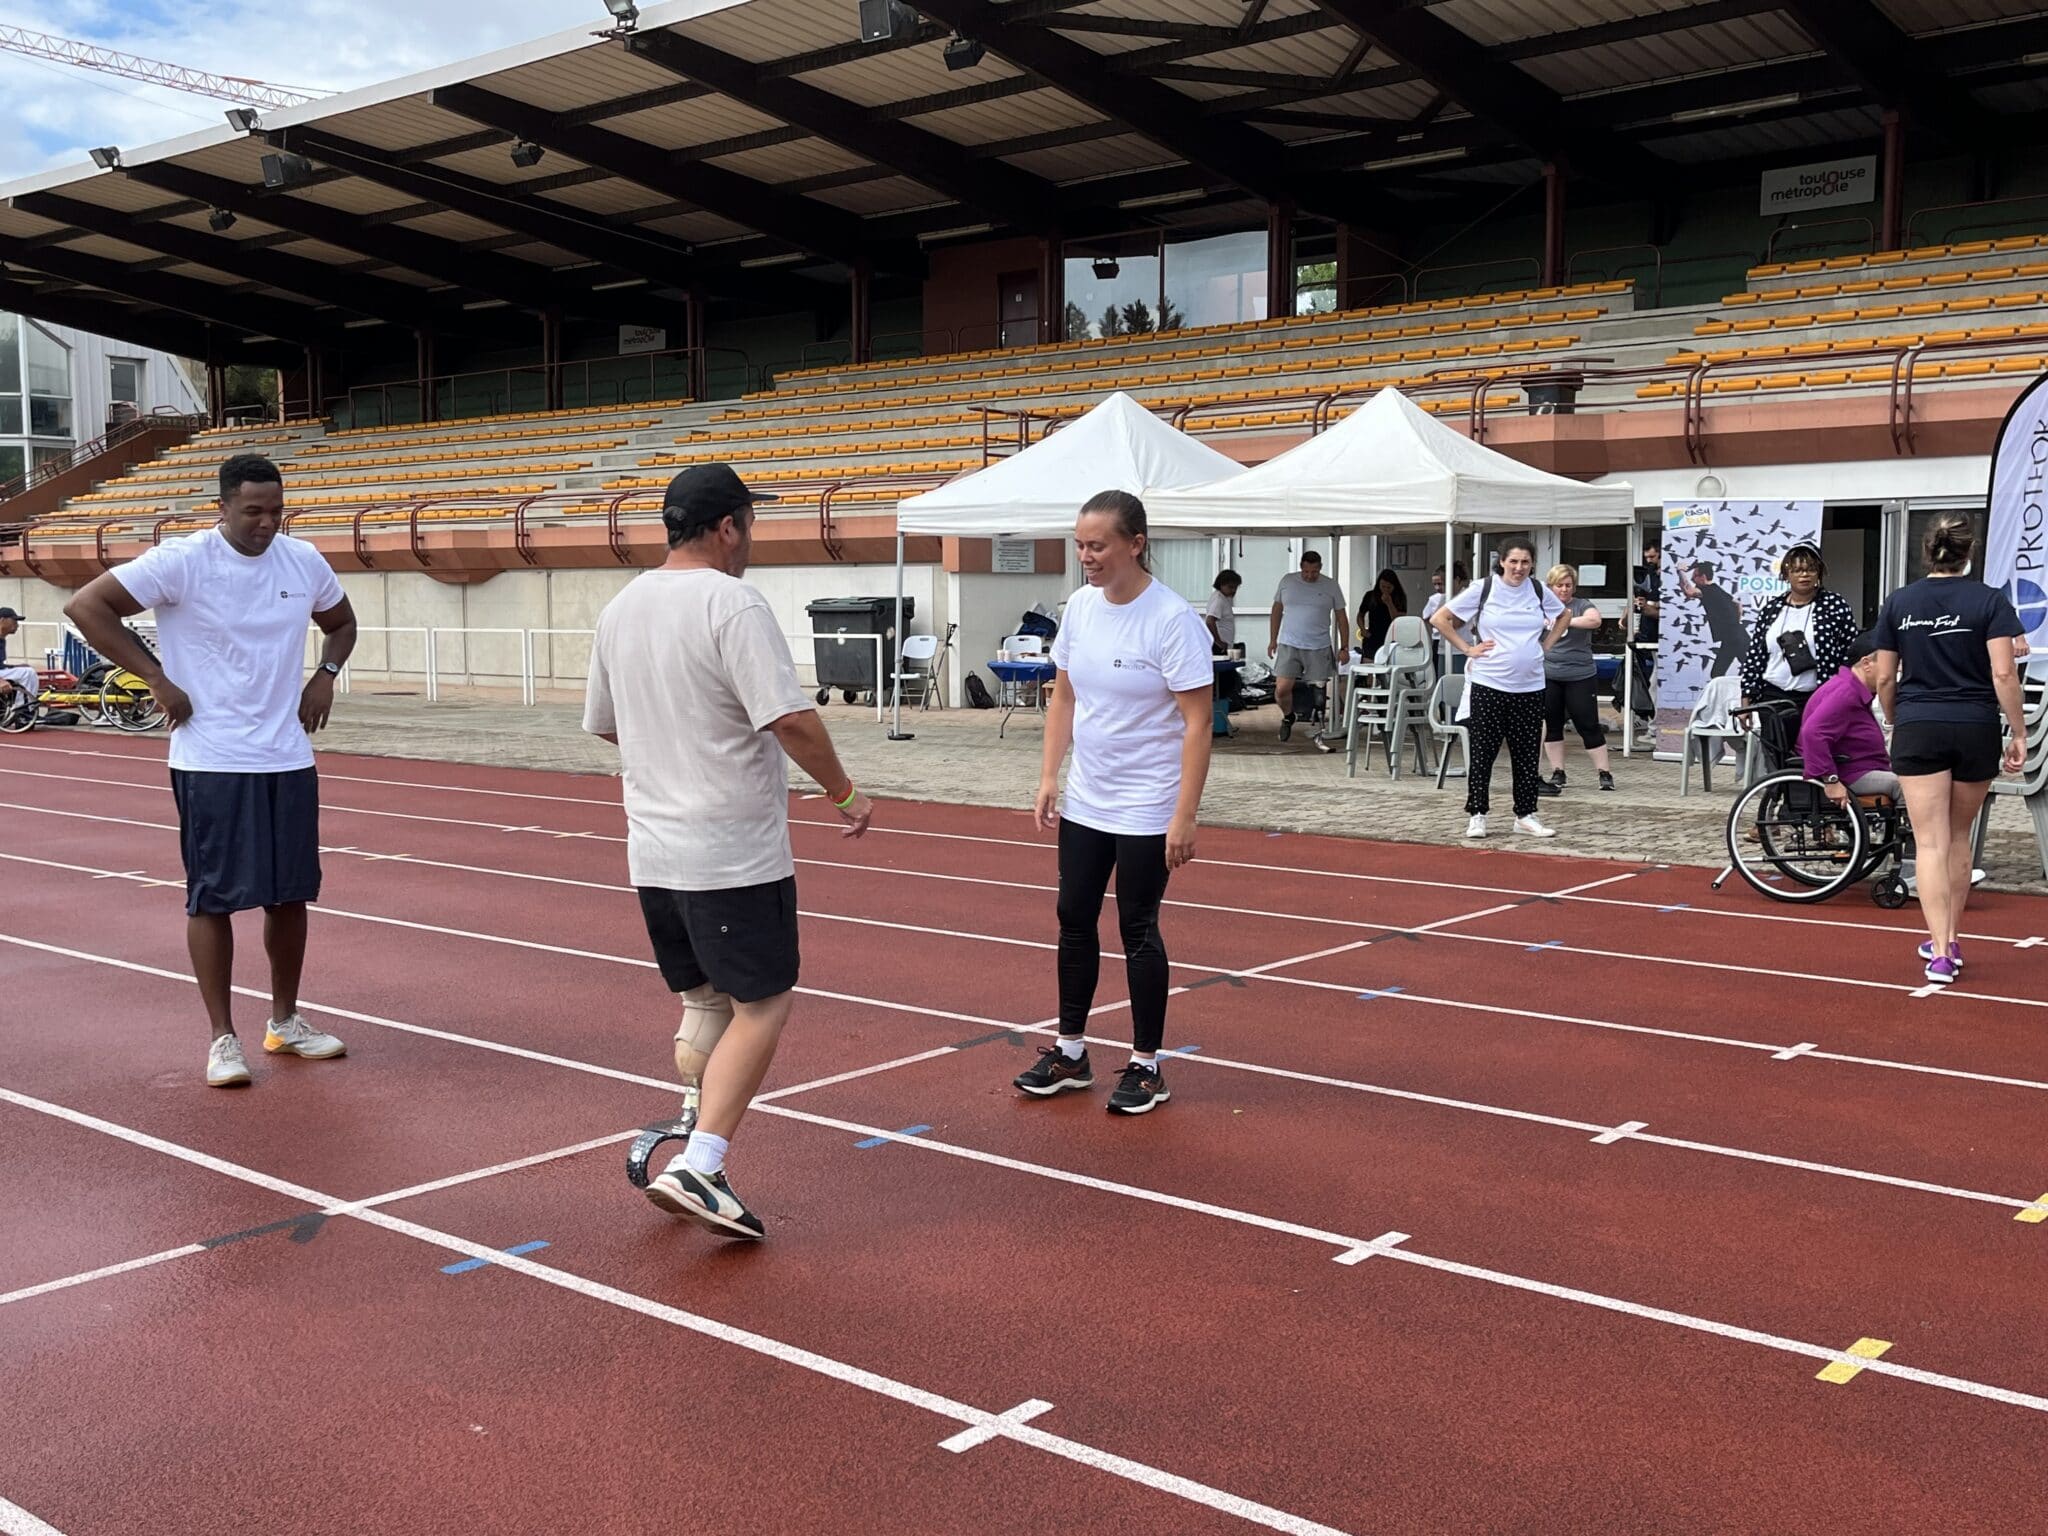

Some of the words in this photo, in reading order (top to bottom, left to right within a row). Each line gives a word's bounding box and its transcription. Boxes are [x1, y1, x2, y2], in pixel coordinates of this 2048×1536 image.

[1799, 168, 1866, 186] toulouse
[1898, 614, 1934, 630] Human
[1933, 614, 1960, 629] First
